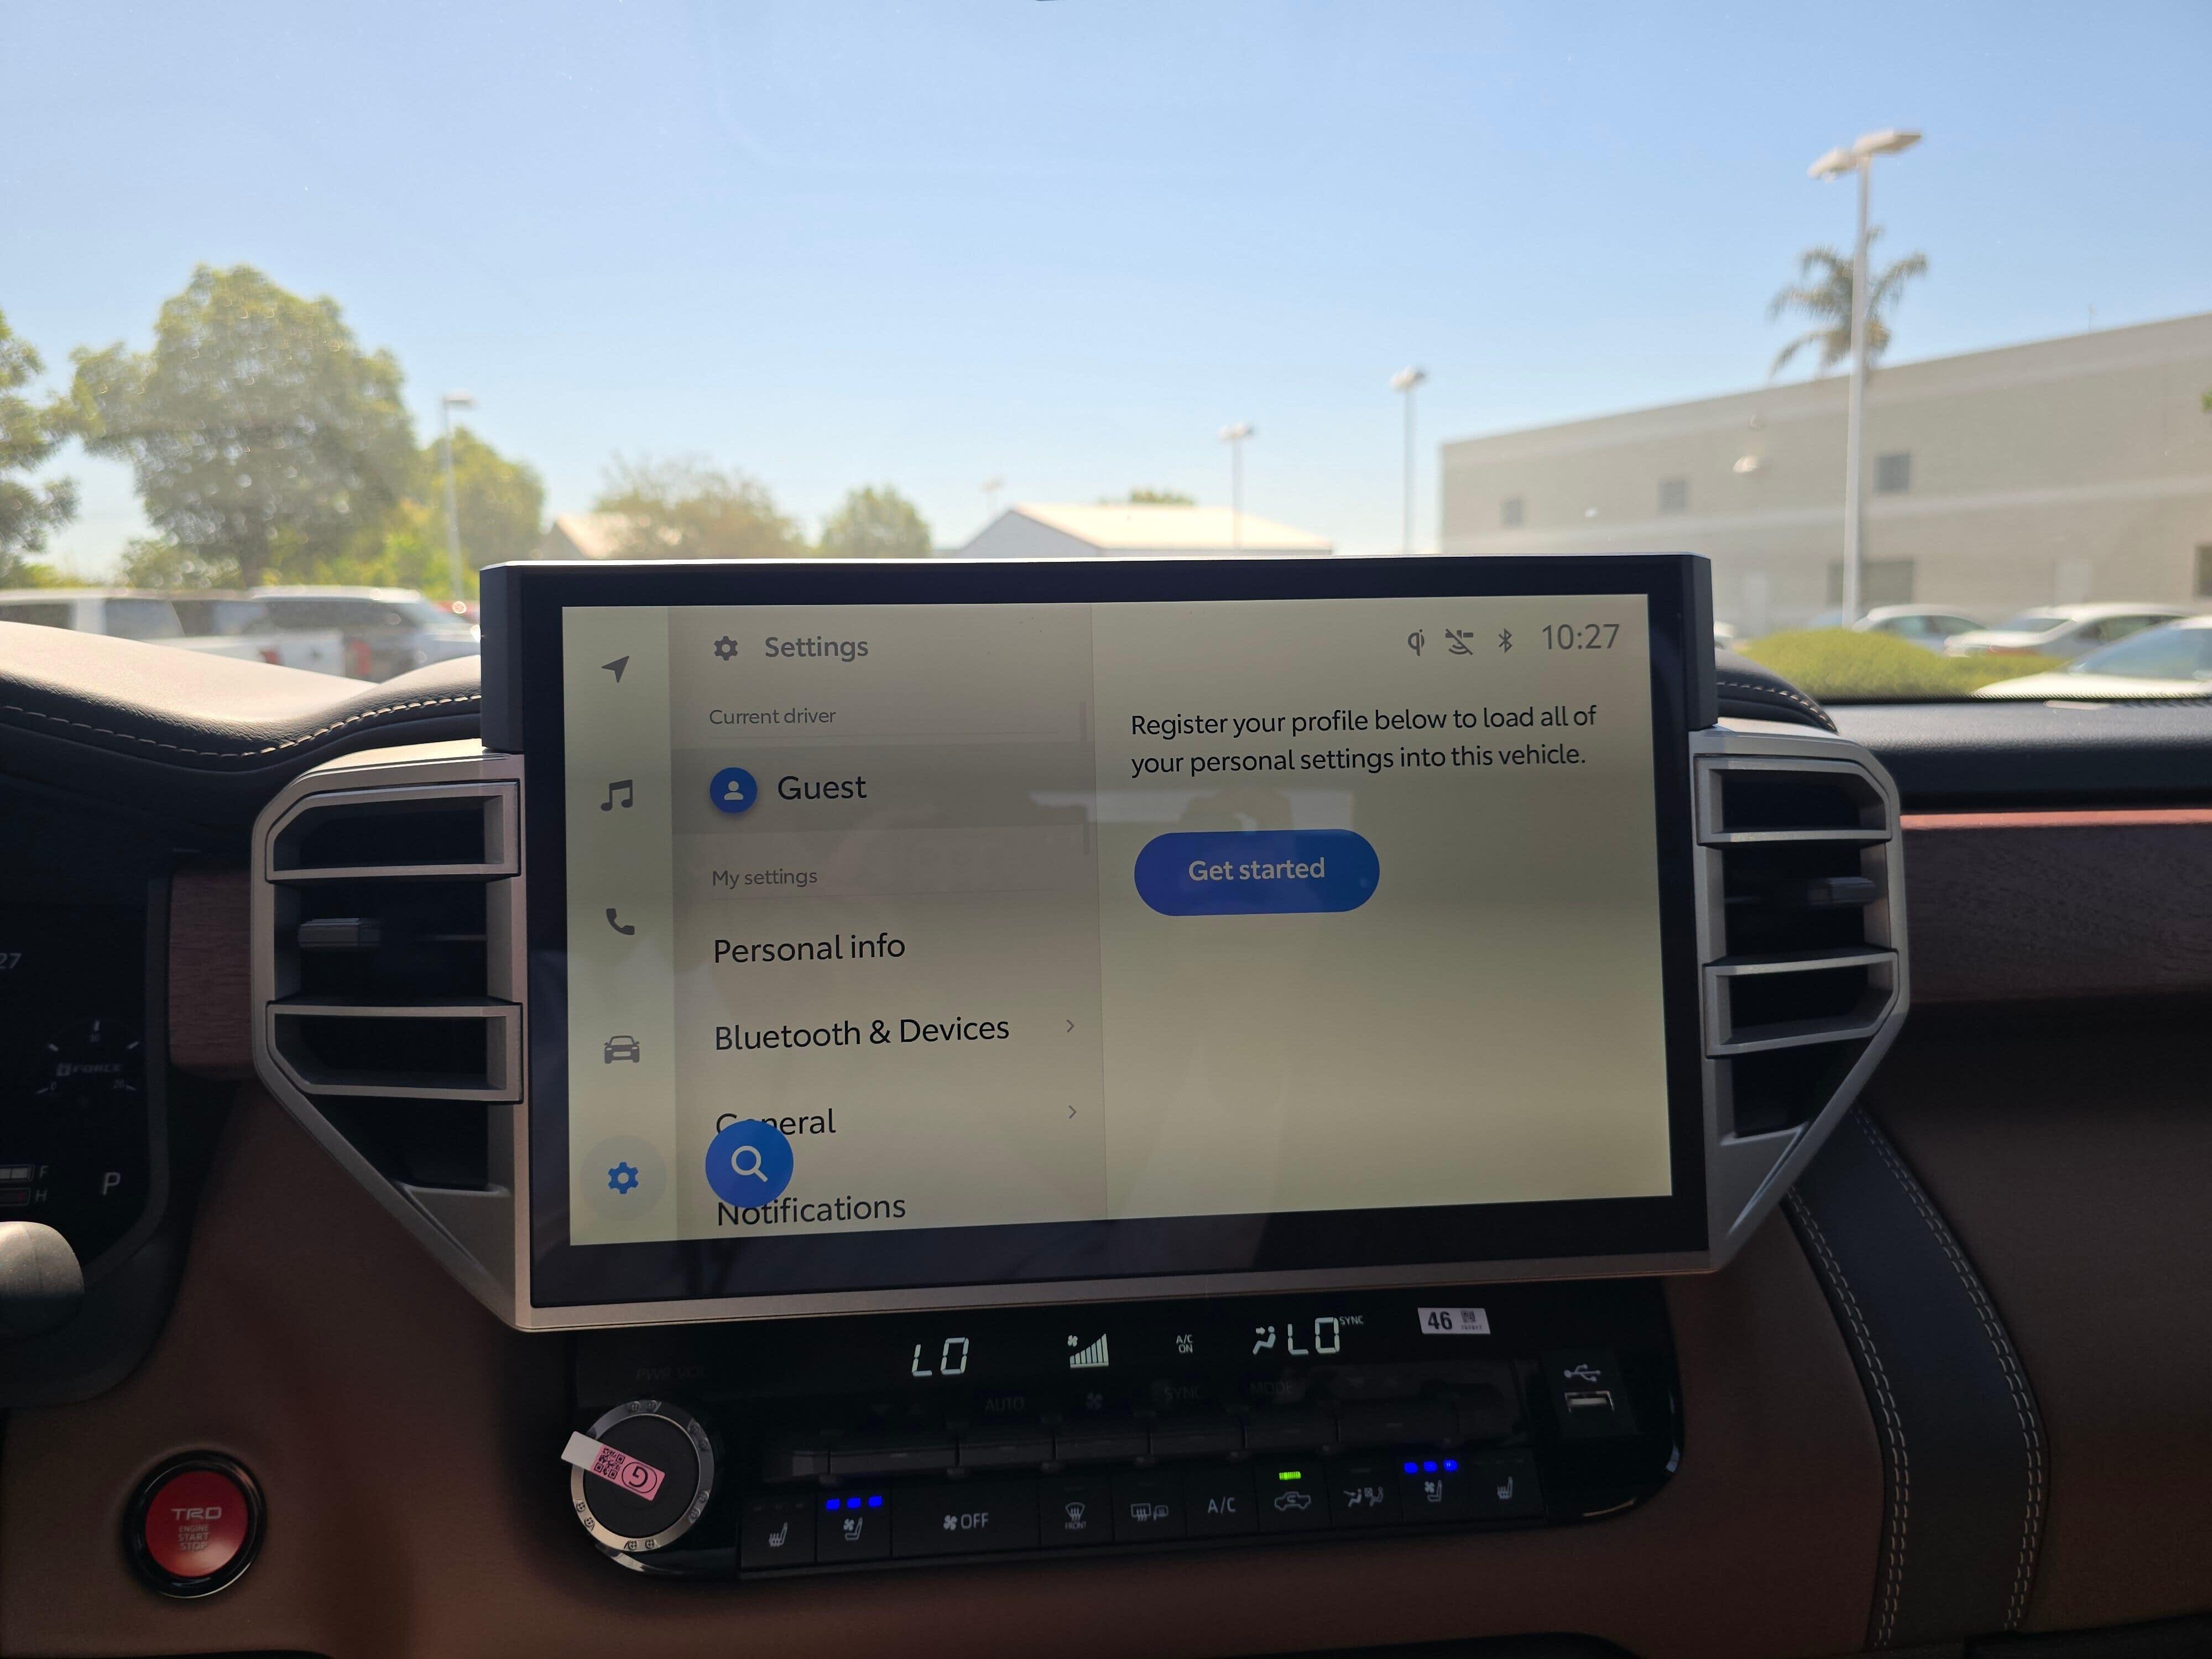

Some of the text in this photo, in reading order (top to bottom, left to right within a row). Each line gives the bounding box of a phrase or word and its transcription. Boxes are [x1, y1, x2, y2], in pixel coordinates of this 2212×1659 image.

[1543, 624, 1619, 650] 10:27
[765, 636, 868, 662] Settings
[710, 708, 836, 724] Current driver
[1133, 705, 1597, 739] Register your profile below to load all of
[1131, 744, 1585, 778] your personal settings into this vehicle.
[779, 776, 867, 800] Guest
[1189, 857, 1324, 880] Get started
[713, 869, 817, 889] My settings
[716, 932, 905, 963] Personal info
[717, 1017, 1009, 1050] Bluetooth & Devices
[40, 1166, 49, 1178] F
[102, 1172, 121, 1195] P
[35, 1190, 47, 1202] H
[718, 1196, 906, 1226] Notifications
[1340, 1316, 1364, 1325] SYNC
[1428, 1312, 1452, 1329] 46
[1176, 1334, 1192, 1343] A/C
[1178, 1344, 1193, 1353] ON
[985, 1397, 1024, 1412] AUTO
[1208, 1498, 1235, 1513] A/C
[171, 1507, 222, 1521] TRD
[961, 1513, 988, 1529] OFF
[1065, 1521, 1087, 1530] FRONT
[179, 1533, 209, 1541] START
